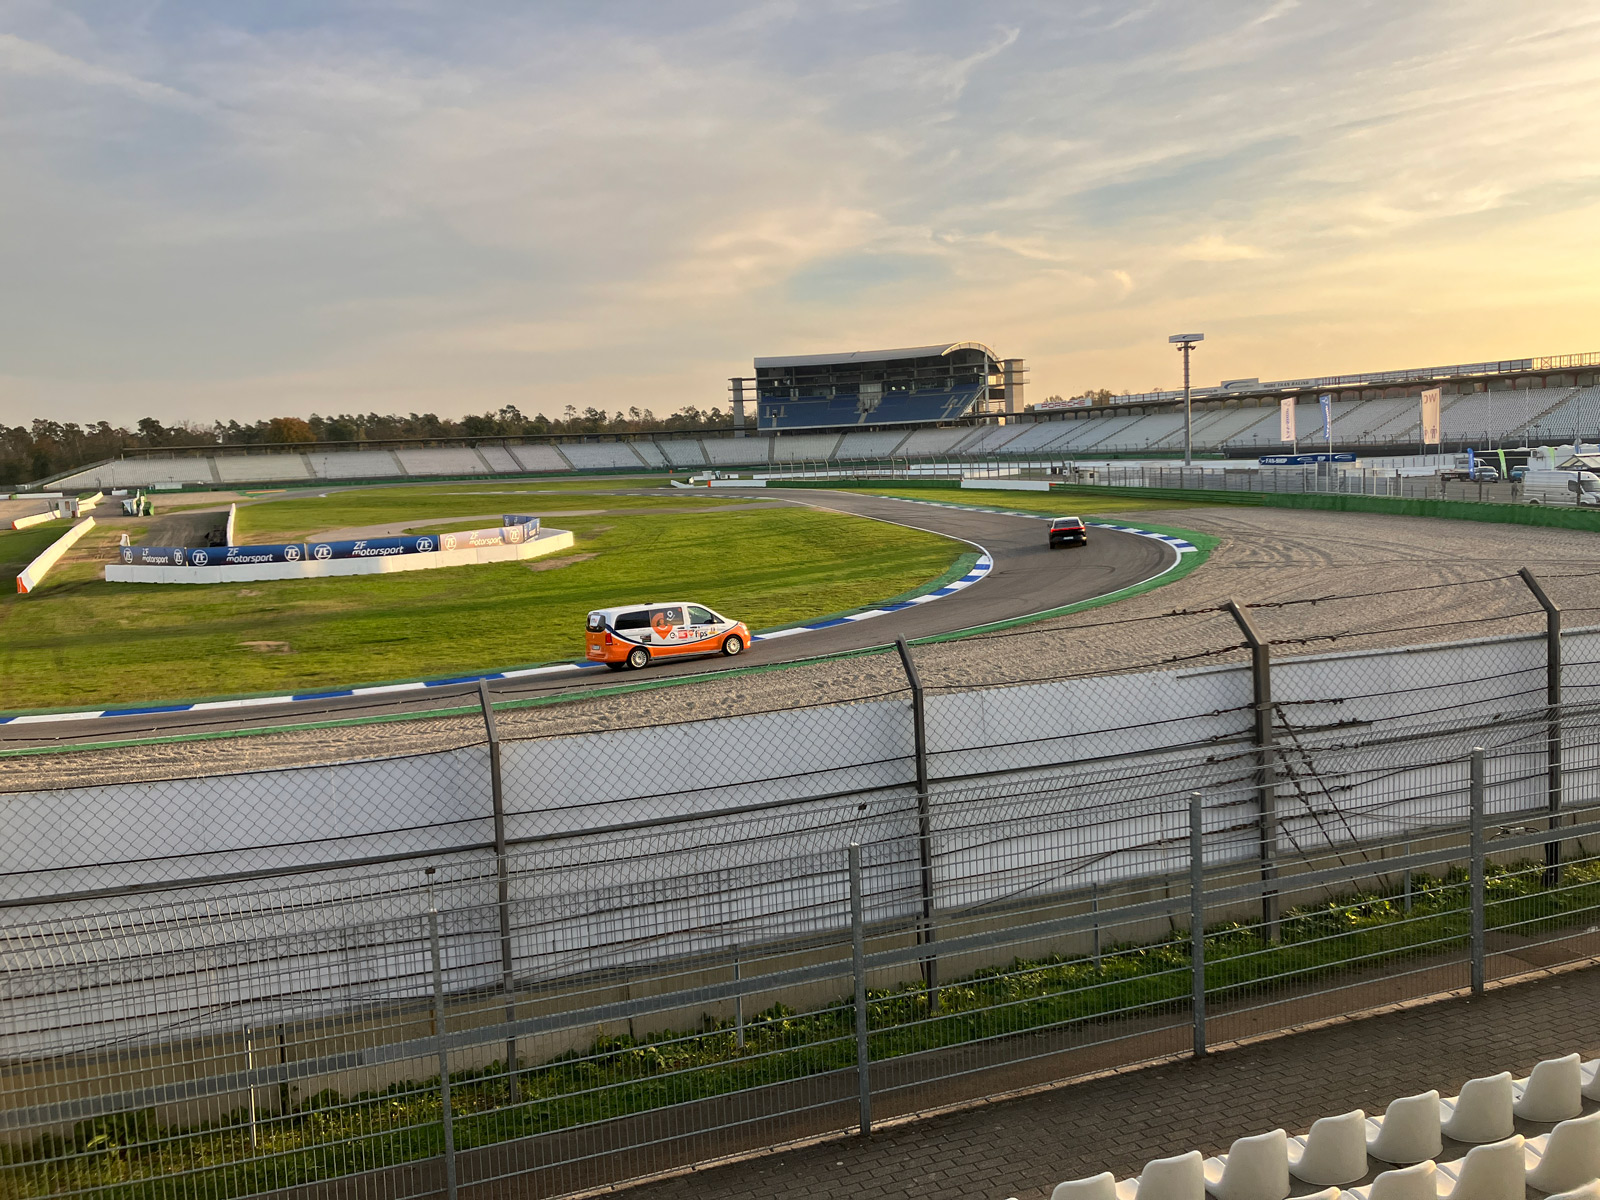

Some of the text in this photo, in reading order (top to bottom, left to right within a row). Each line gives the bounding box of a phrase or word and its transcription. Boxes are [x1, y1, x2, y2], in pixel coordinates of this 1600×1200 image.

[1041, 400, 1086, 409] PORSCHE
[468, 536, 503, 546] motorsport
[469, 532, 480, 540] ZF
[353, 540, 368, 550] ZF
[142, 547, 150, 556] ZF
[227, 547, 240, 557] ZF
[351, 546, 405, 556] motorsport
[142, 556, 169, 564] motorsport
[226, 553, 274, 564] motorsport
